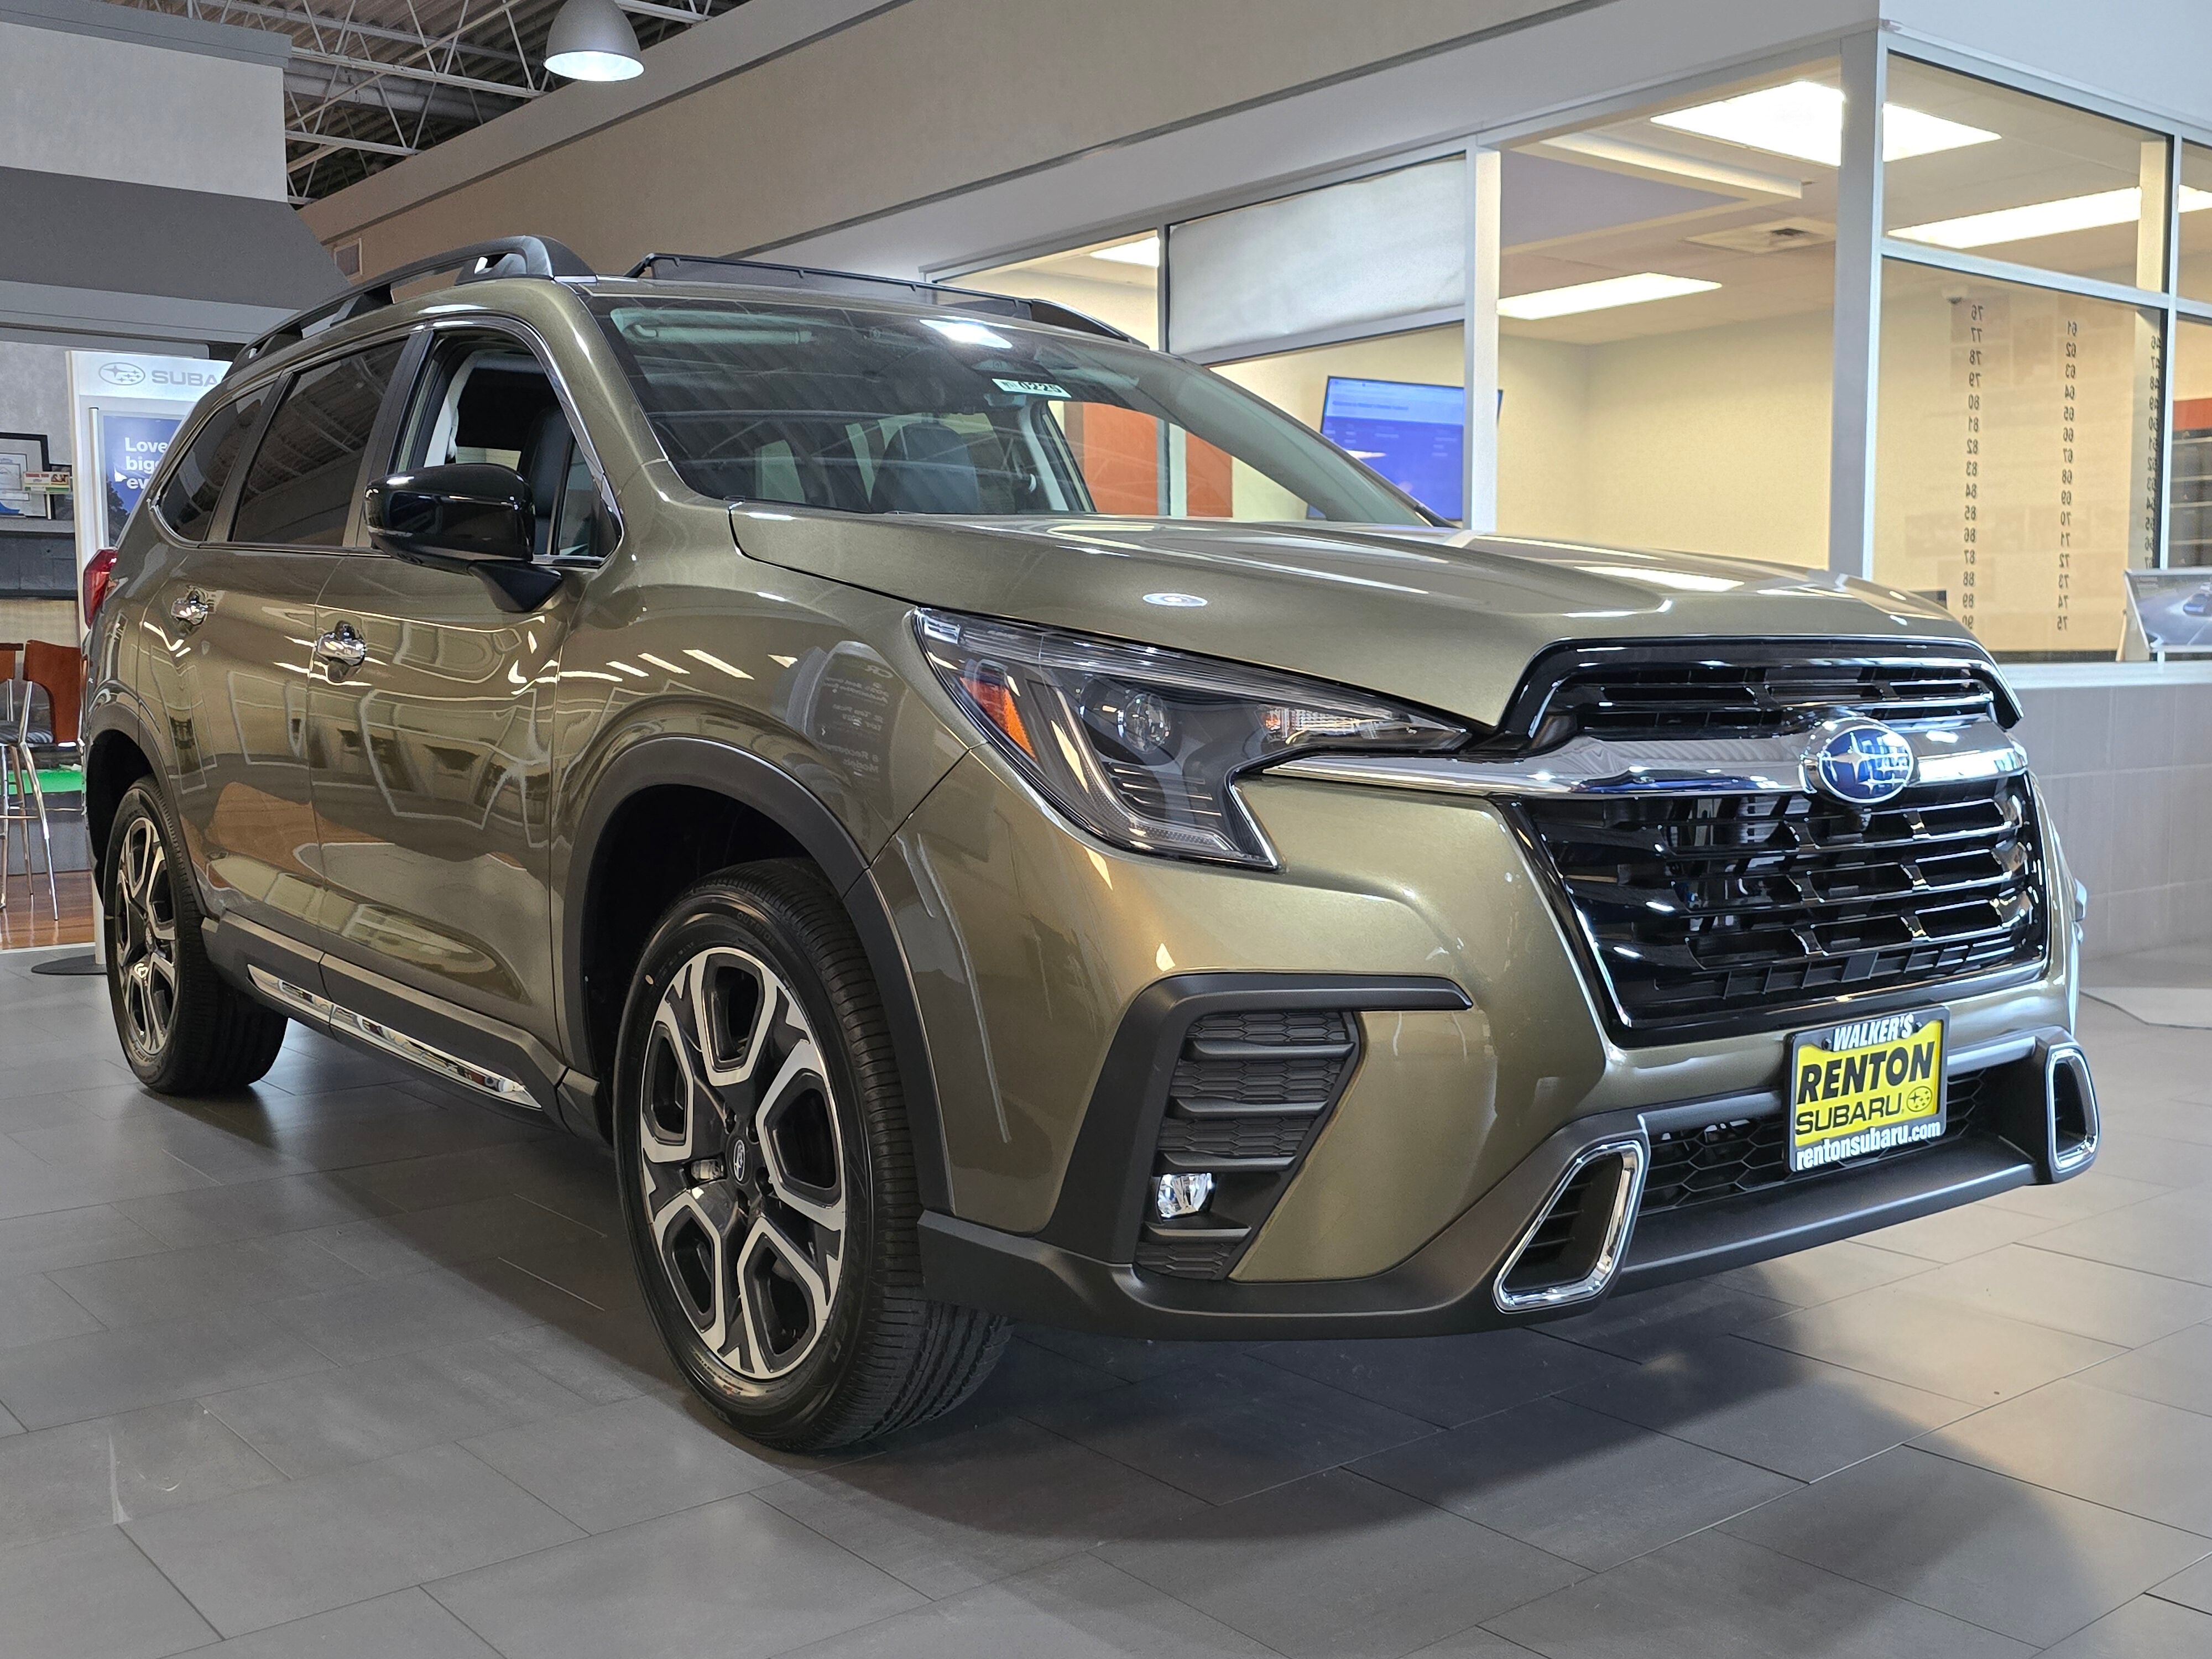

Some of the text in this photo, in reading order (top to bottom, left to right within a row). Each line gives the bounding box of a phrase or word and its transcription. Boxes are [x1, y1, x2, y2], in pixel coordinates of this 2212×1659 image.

[151, 369, 220, 387] SUBA
[126, 477, 150, 489] ev
[1833, 1013, 1914, 1051] WALKER'S
[1797, 1041, 1935, 1105] RENTON
[1796, 1093, 1902, 1135] SUBARU
[1796, 1121, 1941, 1171] rentonsubaru.com
